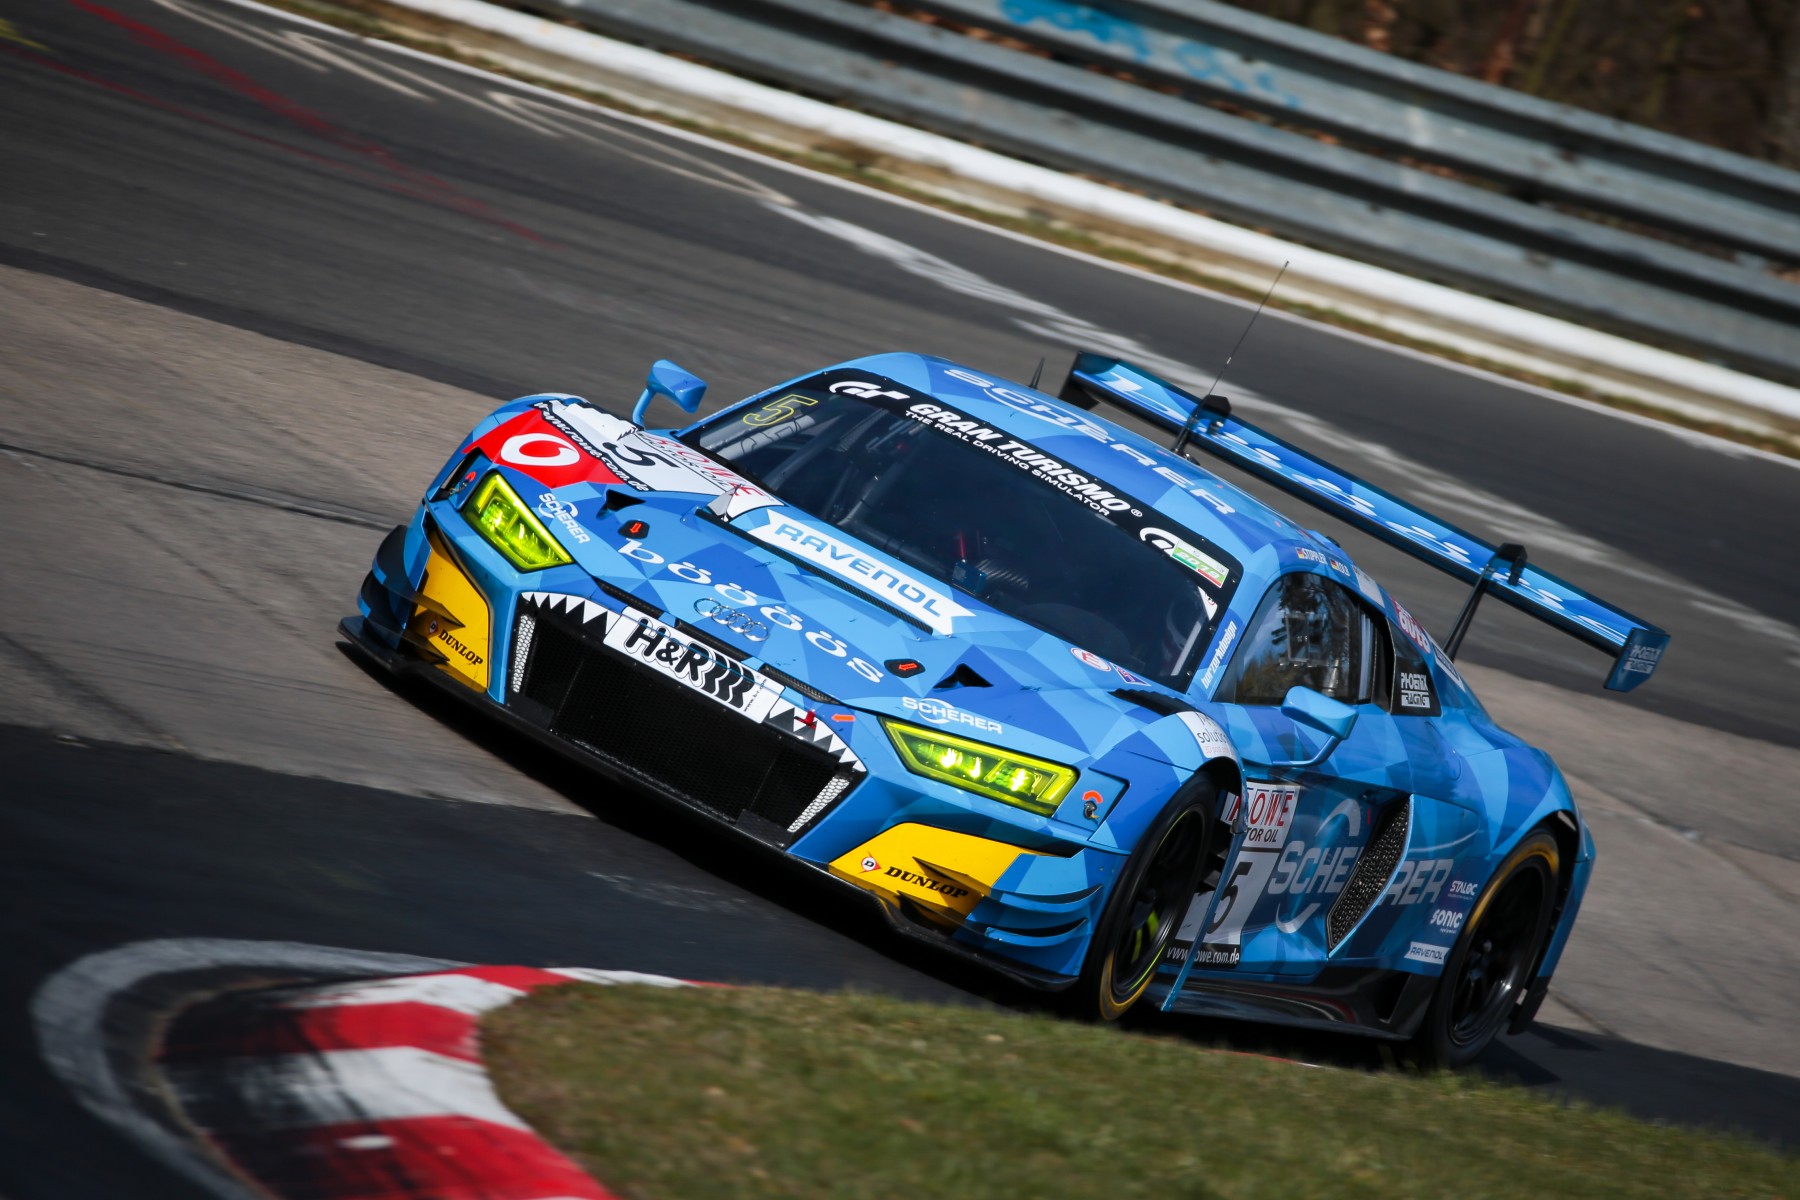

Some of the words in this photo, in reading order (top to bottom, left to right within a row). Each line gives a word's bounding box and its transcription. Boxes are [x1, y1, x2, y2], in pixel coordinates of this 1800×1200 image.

[742, 393, 819, 427] 5
[602, 441, 681, 468] 5
[906, 409, 934, 426] THE
[933, 422, 971, 442] REAL
[972, 440, 1030, 471] DRIVING
[1031, 469, 1110, 517] SIMULATOR
[910, 403, 1003, 442] GRAN
[998, 439, 1132, 511] TURISMO
[944, 367, 1236, 515] SCHERER
[539, 492, 591, 544] SCHERER
[775, 523, 942, 618] RAVENOL
[438, 629, 484, 666] DUNLOP
[622, 616, 722, 690] H&R
[902, 695, 1003, 735] SCHERER
[1263, 829, 1279, 843] OIL
[883, 865, 969, 898] DUNLOP
[1206, 861, 1253, 935] 5
[1450, 880, 1478, 896] STALOC
